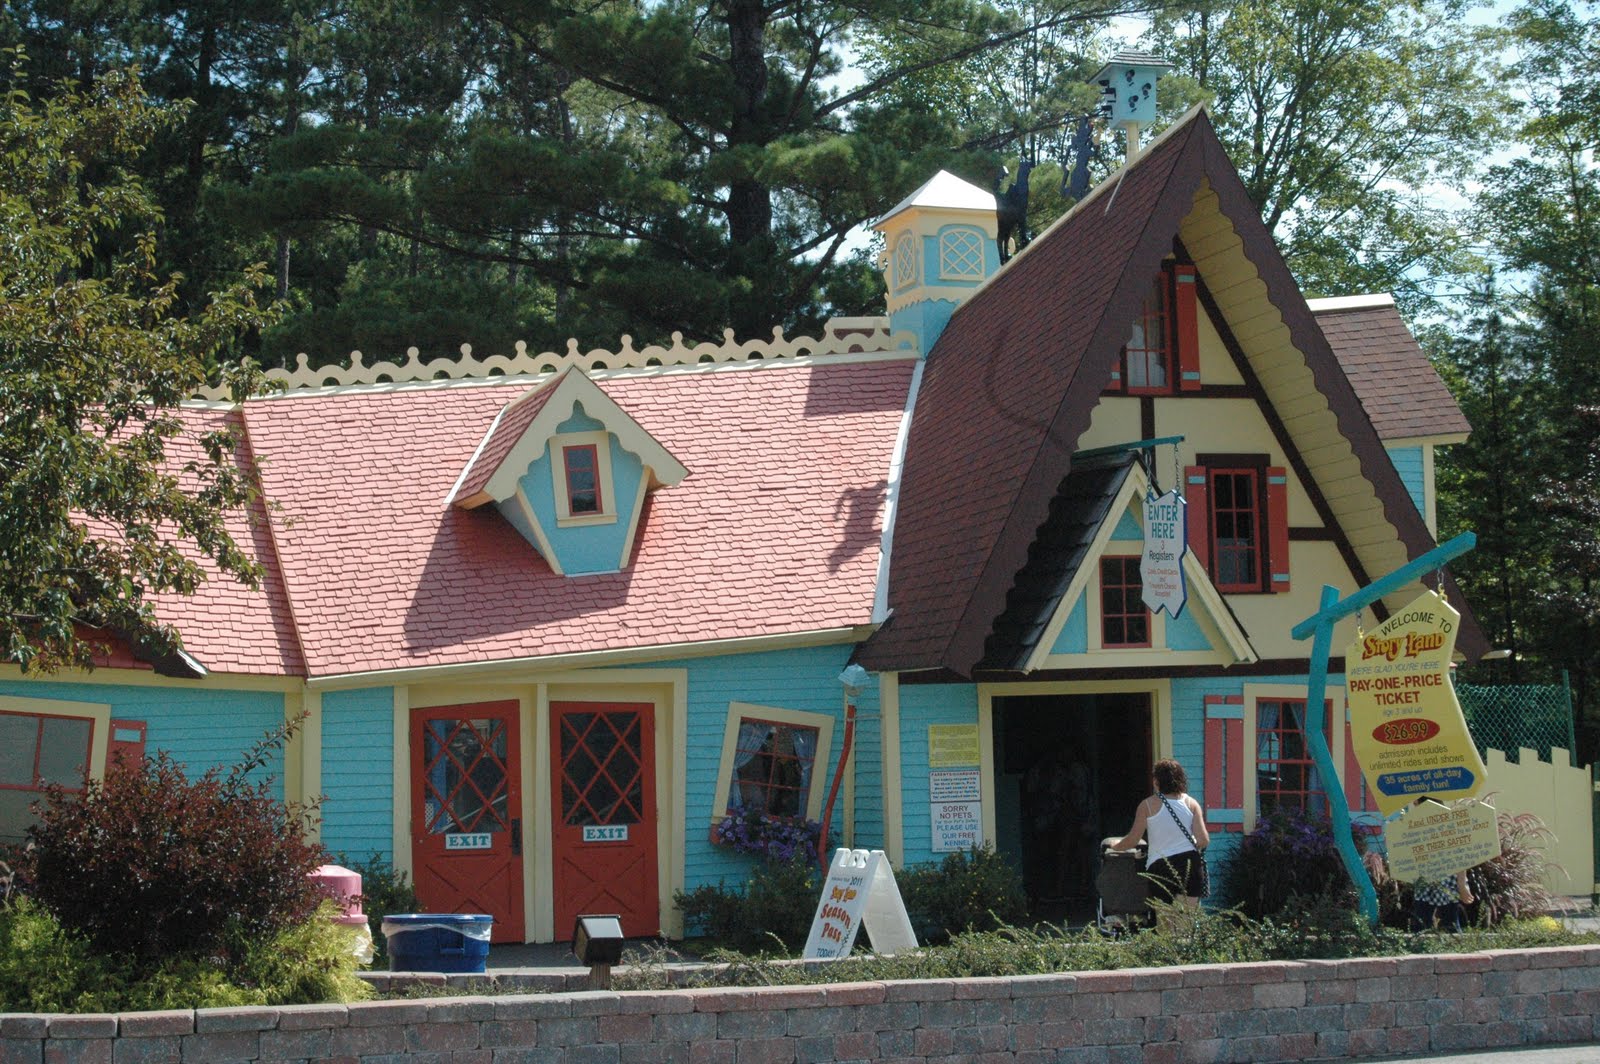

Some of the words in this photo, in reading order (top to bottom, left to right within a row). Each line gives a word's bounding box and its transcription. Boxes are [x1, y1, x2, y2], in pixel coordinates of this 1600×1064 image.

[1148, 505, 1178, 521] ENTER
[1151, 523, 1175, 539] HERE
[1160, 540, 1165, 551] 3
[1149, 550, 1174, 563] Registers
[1381, 612, 1435, 636] WELCOME
[1439, 618, 1452, 634] TO
[1362, 634, 1405, 661] Story
[1404, 632, 1446, 658] Land
[1374, 664, 1392, 673] GLAD
[1395, 663, 1419, 672] YOU'RE
[1421, 661, 1440, 669] HERE
[1350, 674, 1442, 692] PAY-ONE-PRICE
[1374, 691, 1421, 706] TICKET
[1384, 722, 1429, 743] $26.99
[1378, 748, 1416, 760] admission
[1418, 744, 1448, 754] includes
[1369, 760, 1402, 770] unlimited
[1404, 758, 1422, 767] rides
[1425, 756, 1438, 765] and
[1440, 754, 1465, 763] shows
[1384, 776, 1396, 785] 35
[1398, 775, 1420, 784] acres
[1423, 772, 1432, 781] of
[1434, 768, 1462, 780] all-day
[1403, 782, 1430, 793] family
[1432, 779, 1450, 788] fun!
[1426, 814, 1450, 825] UNDER
[1452, 809, 1469, 819] FREE
[449, 836, 490, 847] EXIT
[586, 828, 626, 840] EXIT
[1412, 844, 1424, 854] FOR
[1426, 840, 1446, 850] THEIR
[1447, 834, 1472, 846] SAFETY
[850, 876, 862, 886] 2011
[820, 904, 851, 929] Season
[821, 922, 842, 943] Pass
